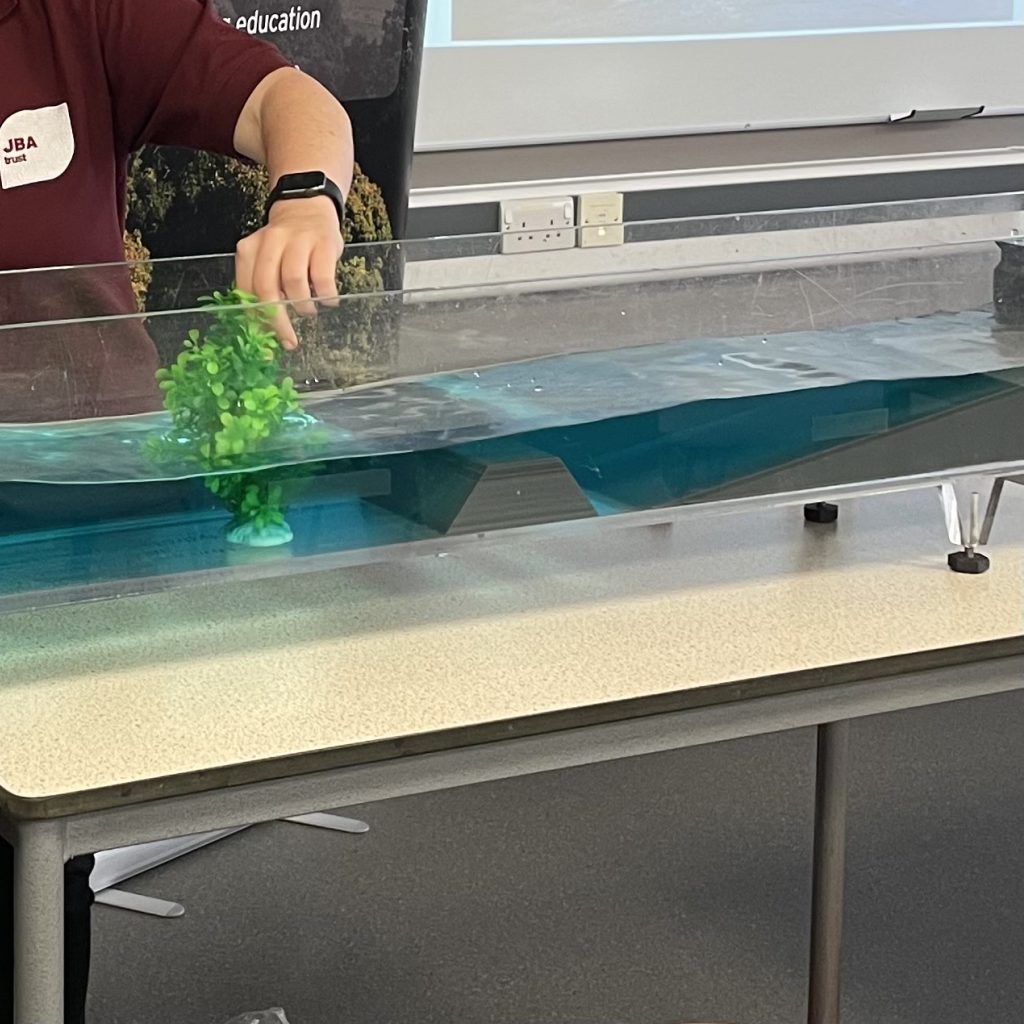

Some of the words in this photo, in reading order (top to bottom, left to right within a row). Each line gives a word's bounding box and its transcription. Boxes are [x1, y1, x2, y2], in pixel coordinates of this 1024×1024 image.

[236, 6, 321, 34] education
[3, 136, 38, 153] JBA
[4, 154, 27, 164] trust
